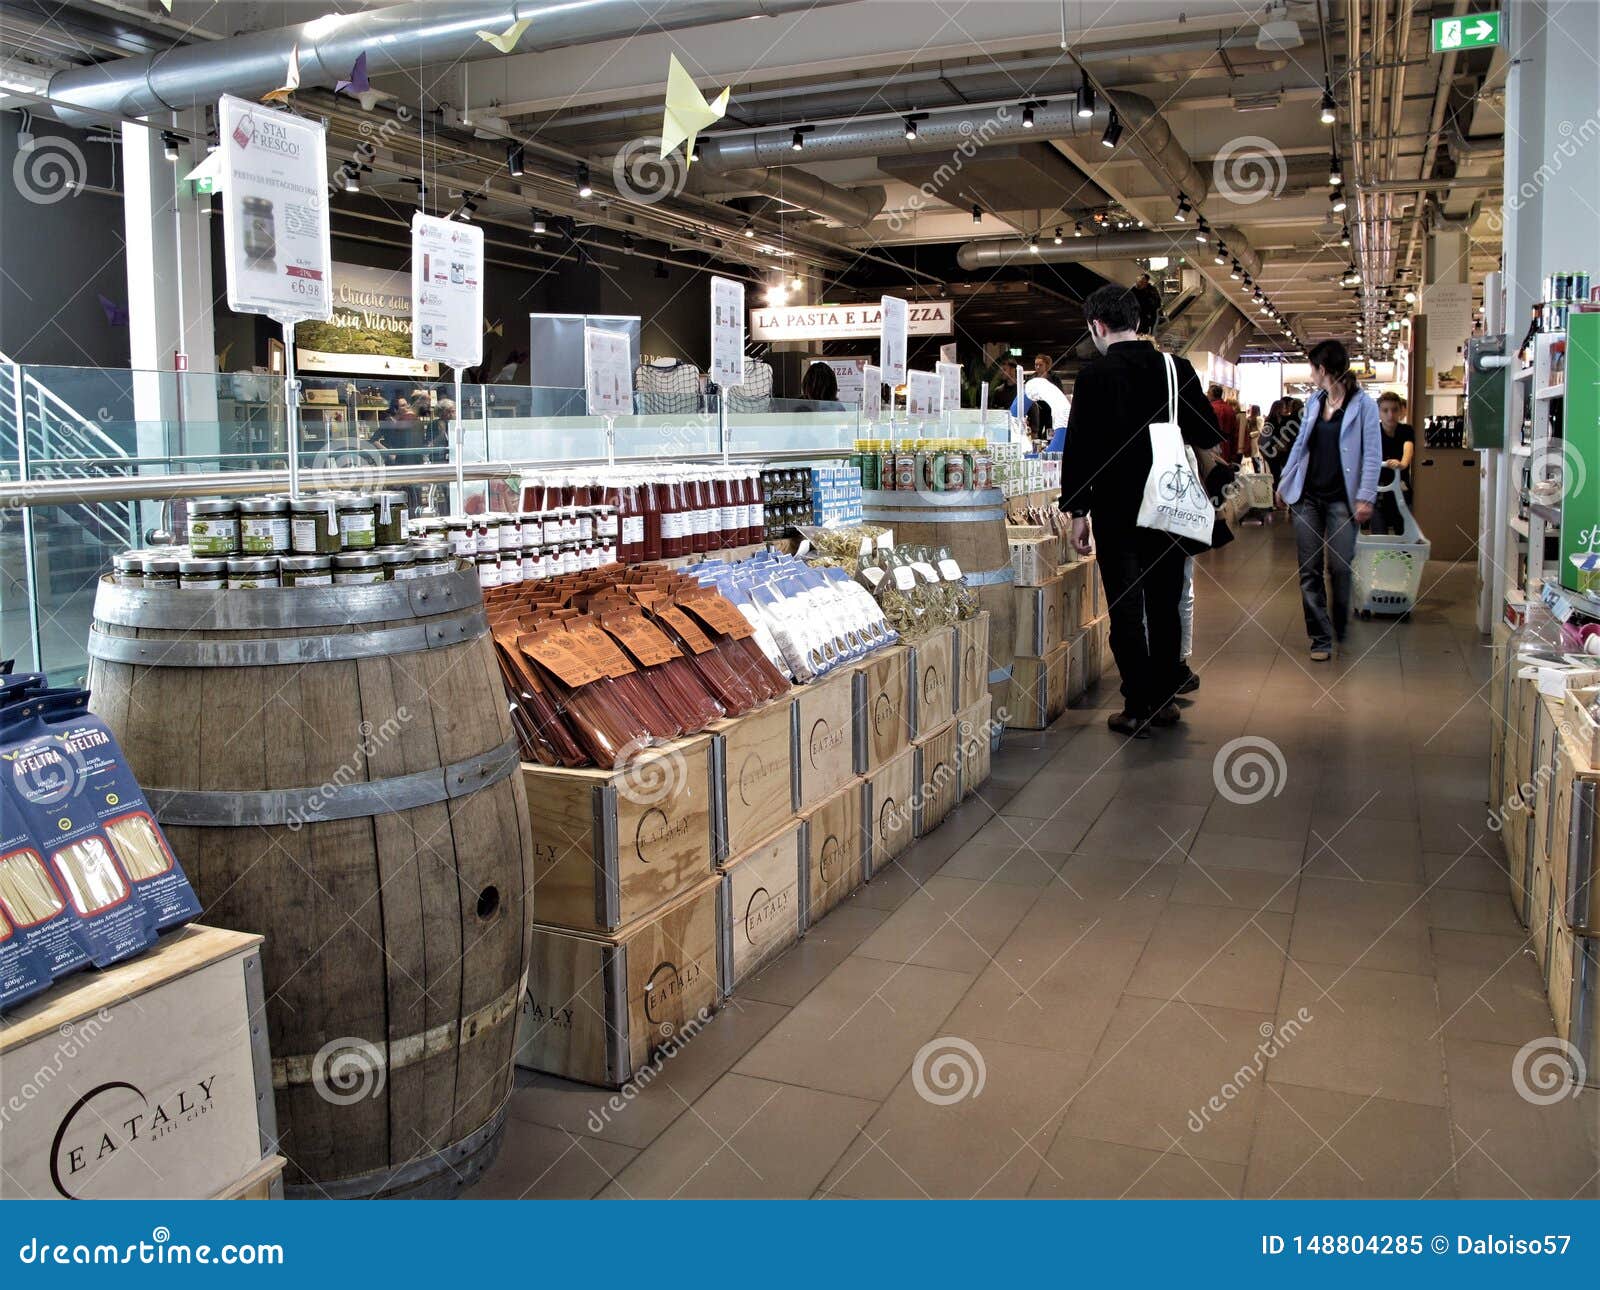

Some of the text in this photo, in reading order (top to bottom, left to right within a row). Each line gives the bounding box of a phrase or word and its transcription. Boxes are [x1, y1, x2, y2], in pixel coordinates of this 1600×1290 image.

[263, 122, 287, 140] STAI
[340, 282, 385, 308] Chicche
[759, 308, 945, 328] LA PASTA E LA ZZA
[64, 731, 110, 754] AFELTRA
[14, 750, 62, 776] AFELTRA
[749, 890, 789, 931] EATALY
[650, 960, 702, 1009] EATALY
[523, 1002, 574, 1023] TALY
[67, 1074, 216, 1175] EATALY
